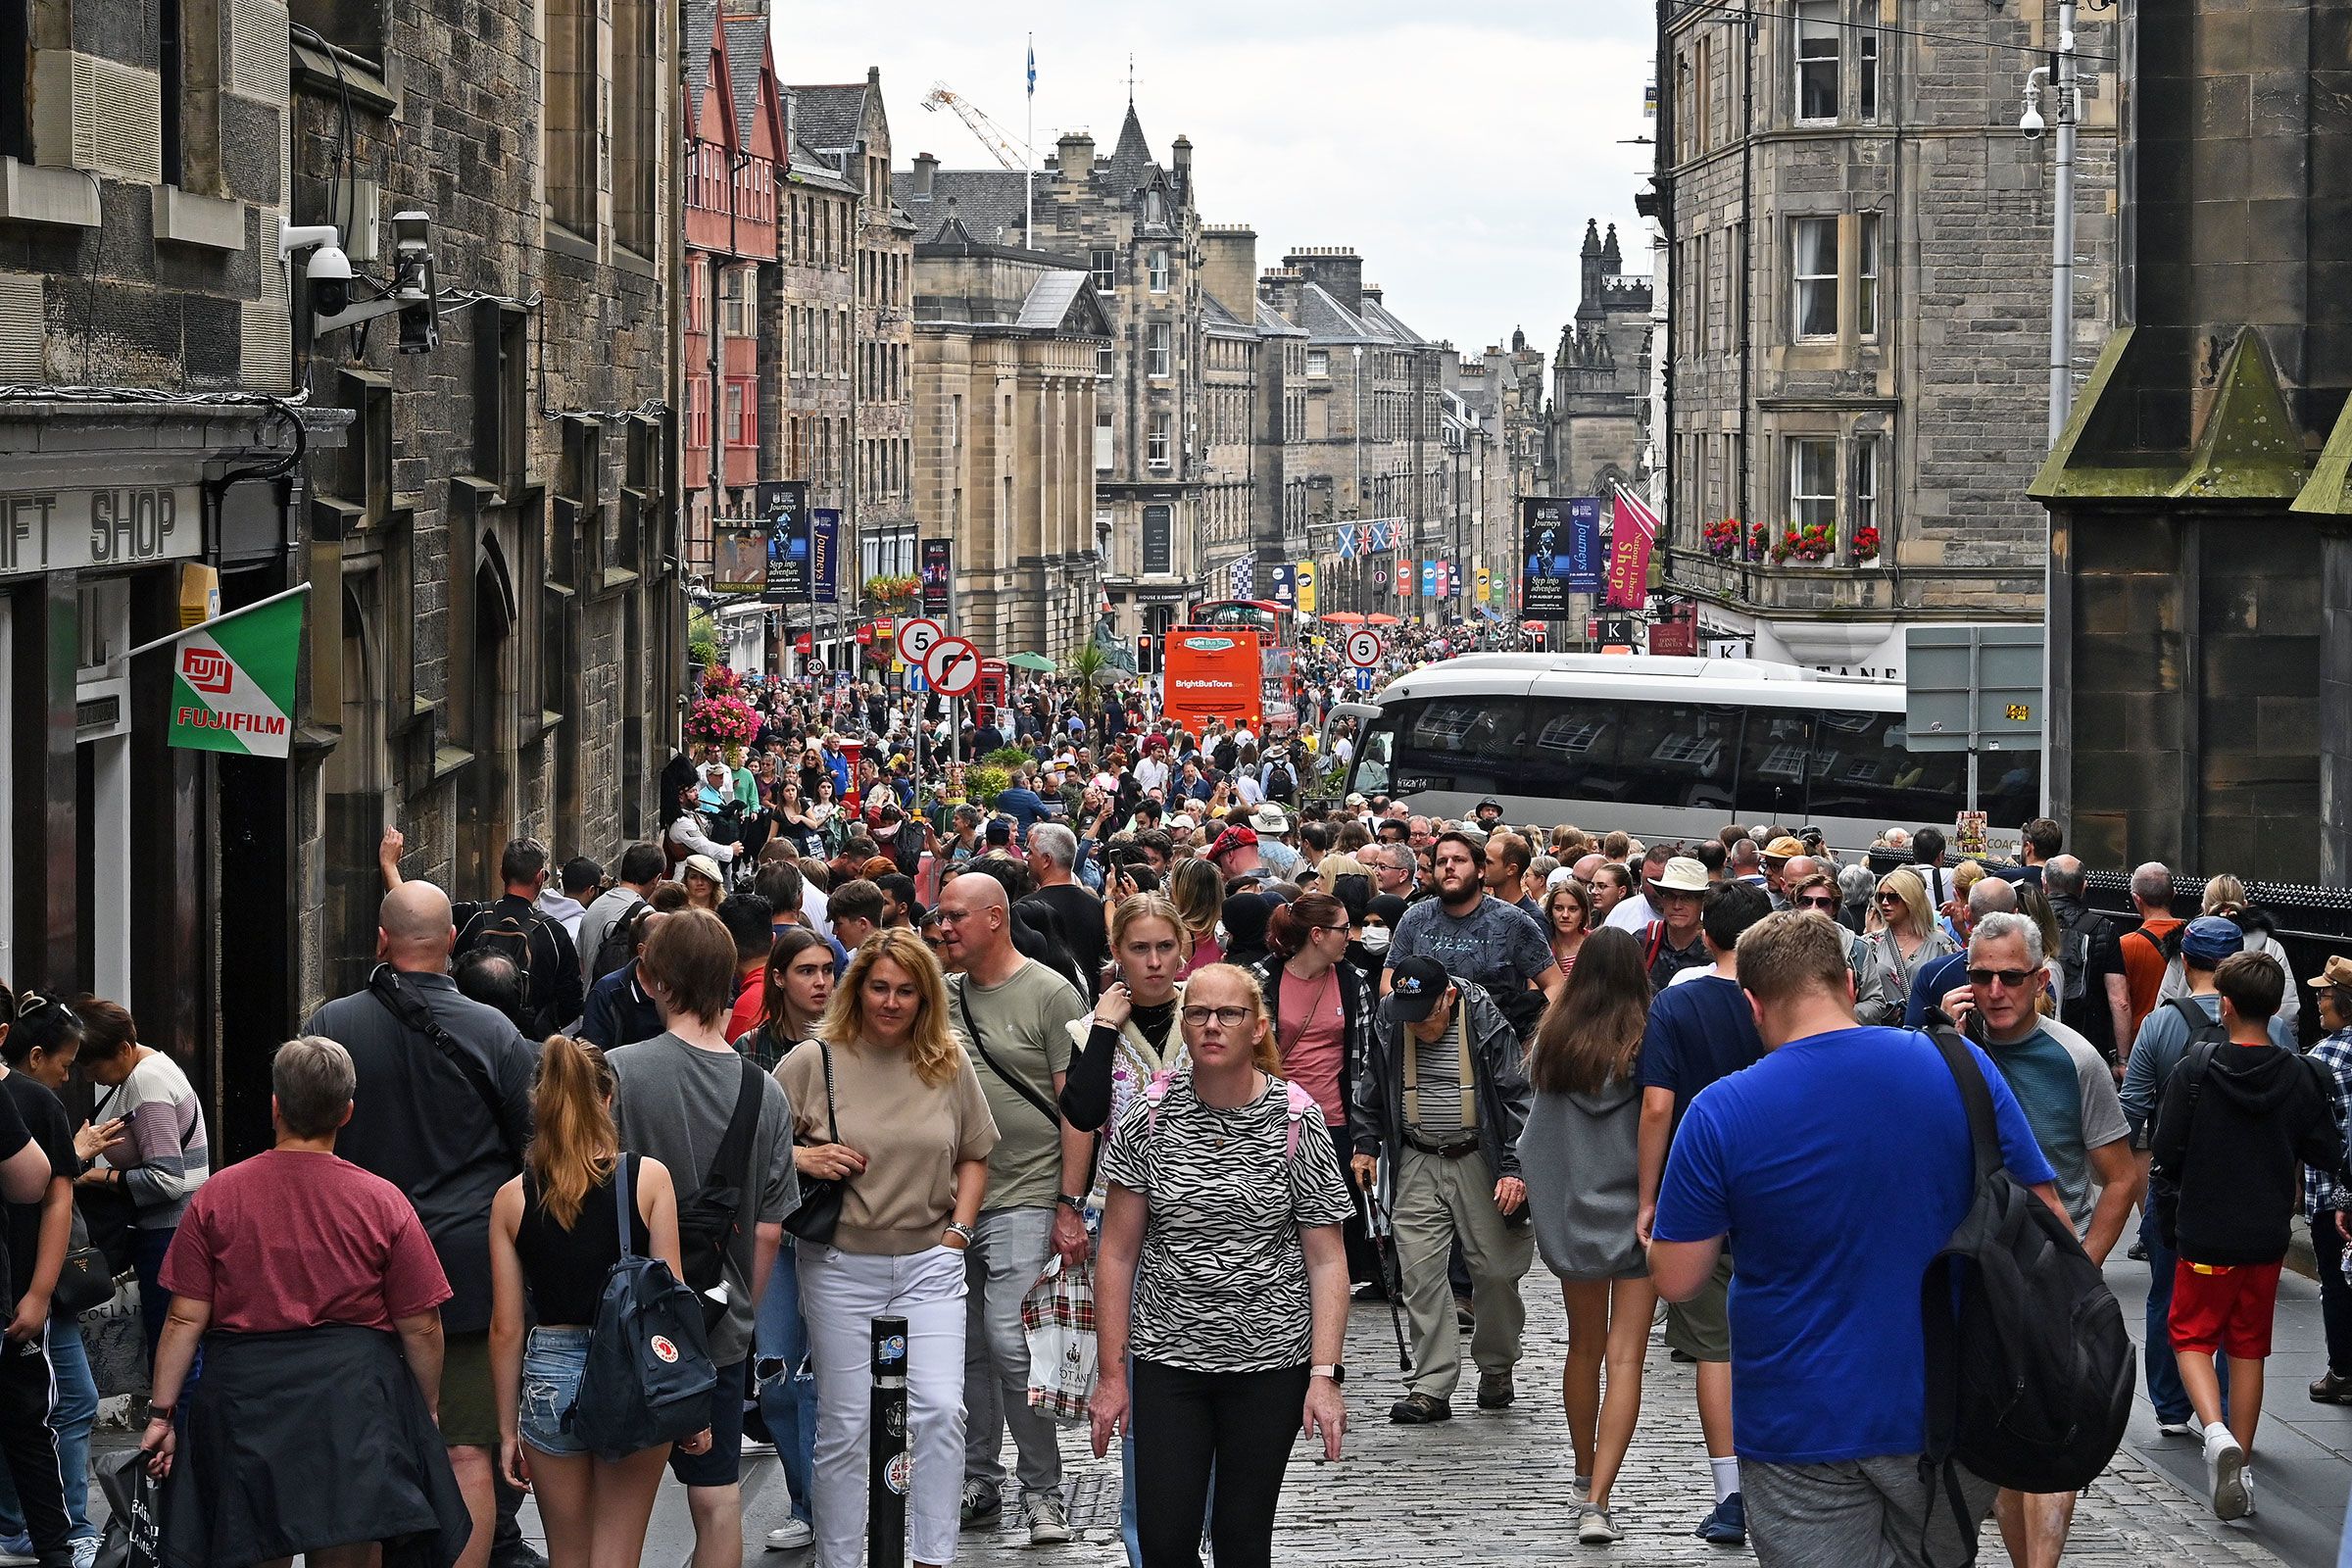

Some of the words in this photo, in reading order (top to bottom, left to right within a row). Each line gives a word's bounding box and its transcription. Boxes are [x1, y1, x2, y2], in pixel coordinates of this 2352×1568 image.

[768, 503, 796, 512] Journeys
[90, 489, 176, 564] SHOP
[1532, 519, 1561, 529] Journeys
[1575, 520, 1590, 571] Journeys
[1632, 532, 1642, 567] National
[815, 530, 829, 580] Journeys
[769, 560, 783, 568] Step
[1612, 542, 1632, 589] Shop
[1532, 576, 1545, 585] Step
[1546, 576, 1559, 584] into
[1626, 572, 1638, 602] Library
[1609, 623, 1620, 637] K
[914, 632, 928, 651] 5
[1358, 641, 1369, 657] 5
[809, 662, 820, 671] 20
[177, 707, 285, 736] FUJIFILM
[20, 1347, 41, 1357] adidas
